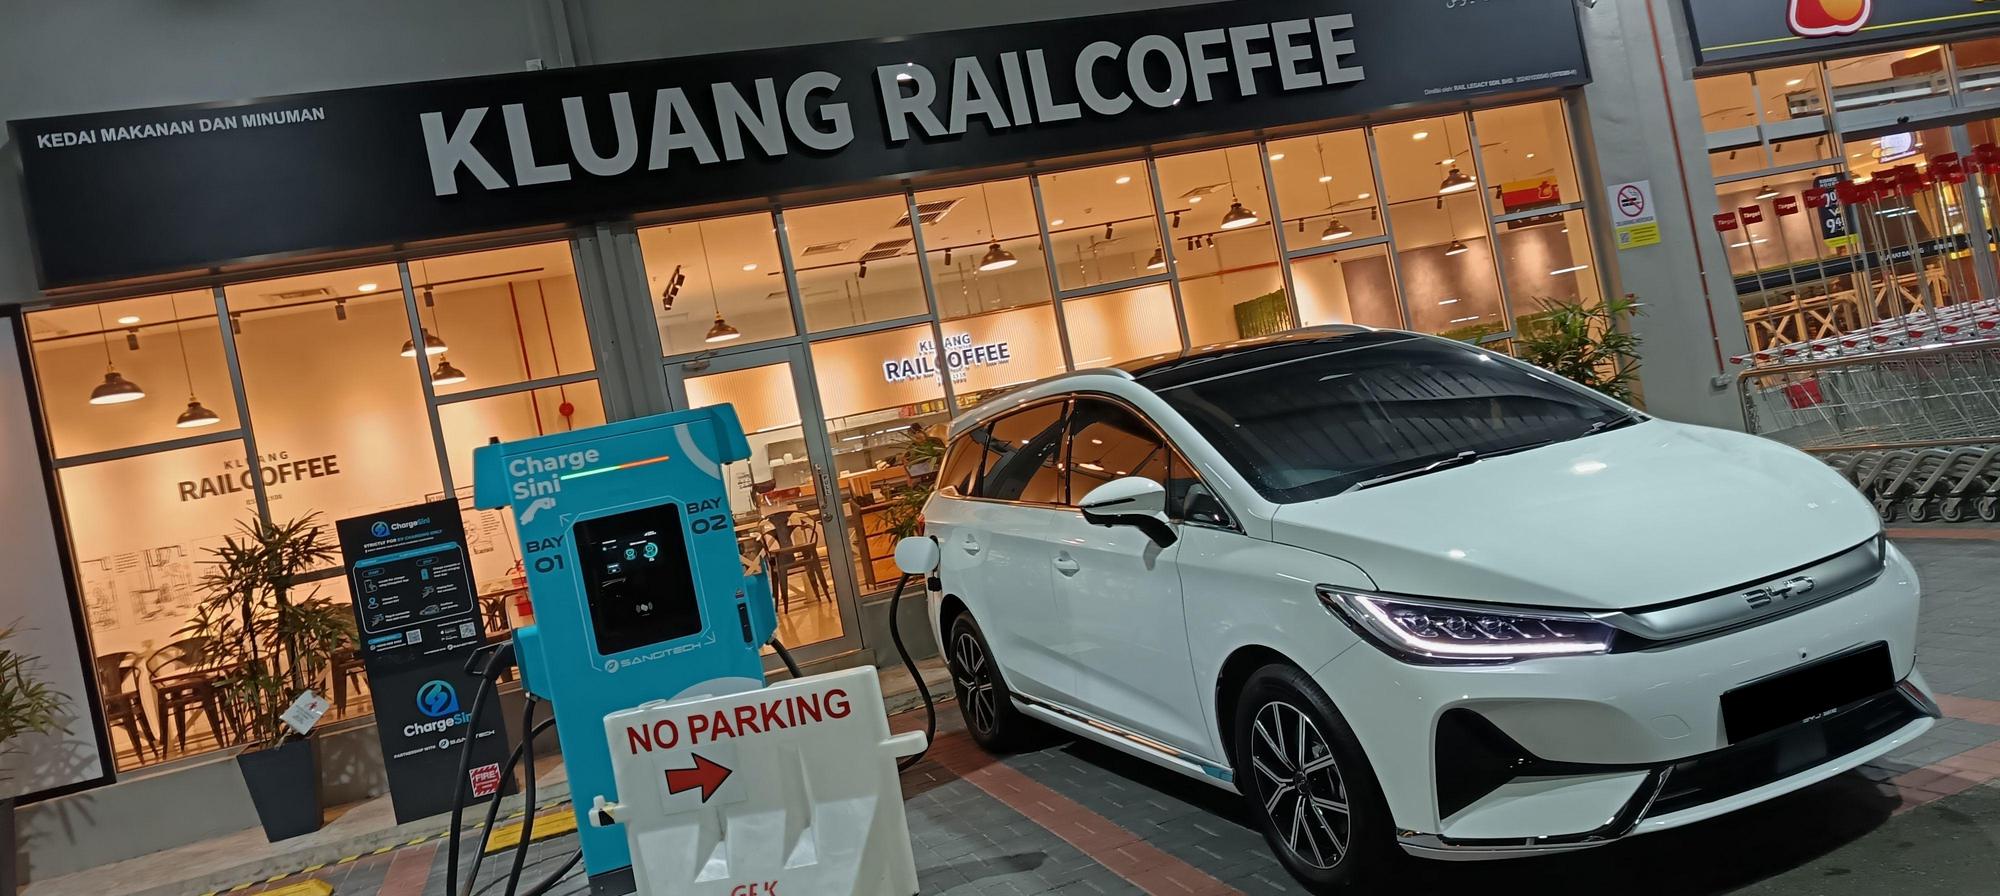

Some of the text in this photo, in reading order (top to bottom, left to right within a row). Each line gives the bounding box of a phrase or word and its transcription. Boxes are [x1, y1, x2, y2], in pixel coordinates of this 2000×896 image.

[420, 13, 1366, 196] KLUANG RAILCOFFEE
[37, 107, 326, 149] KEDAI MAKANAN DAN MINUMAN
[919, 333, 971, 351] KLANG
[885, 342, 1010, 380] RAILOFFEE
[224, 451, 289, 470] KLANG
[509, 449, 600, 477] Charge
[513, 474, 561, 500] Sini
[686, 497, 722, 514] BAY
[691, 514, 728, 535] 02
[526, 535, 565, 553] BAY
[534, 554, 565, 573] 01
[403, 711, 472, 737] ChargeSin
[626, 688, 852, 755] NO PARKING
[475, 770, 497, 782] FIRE
